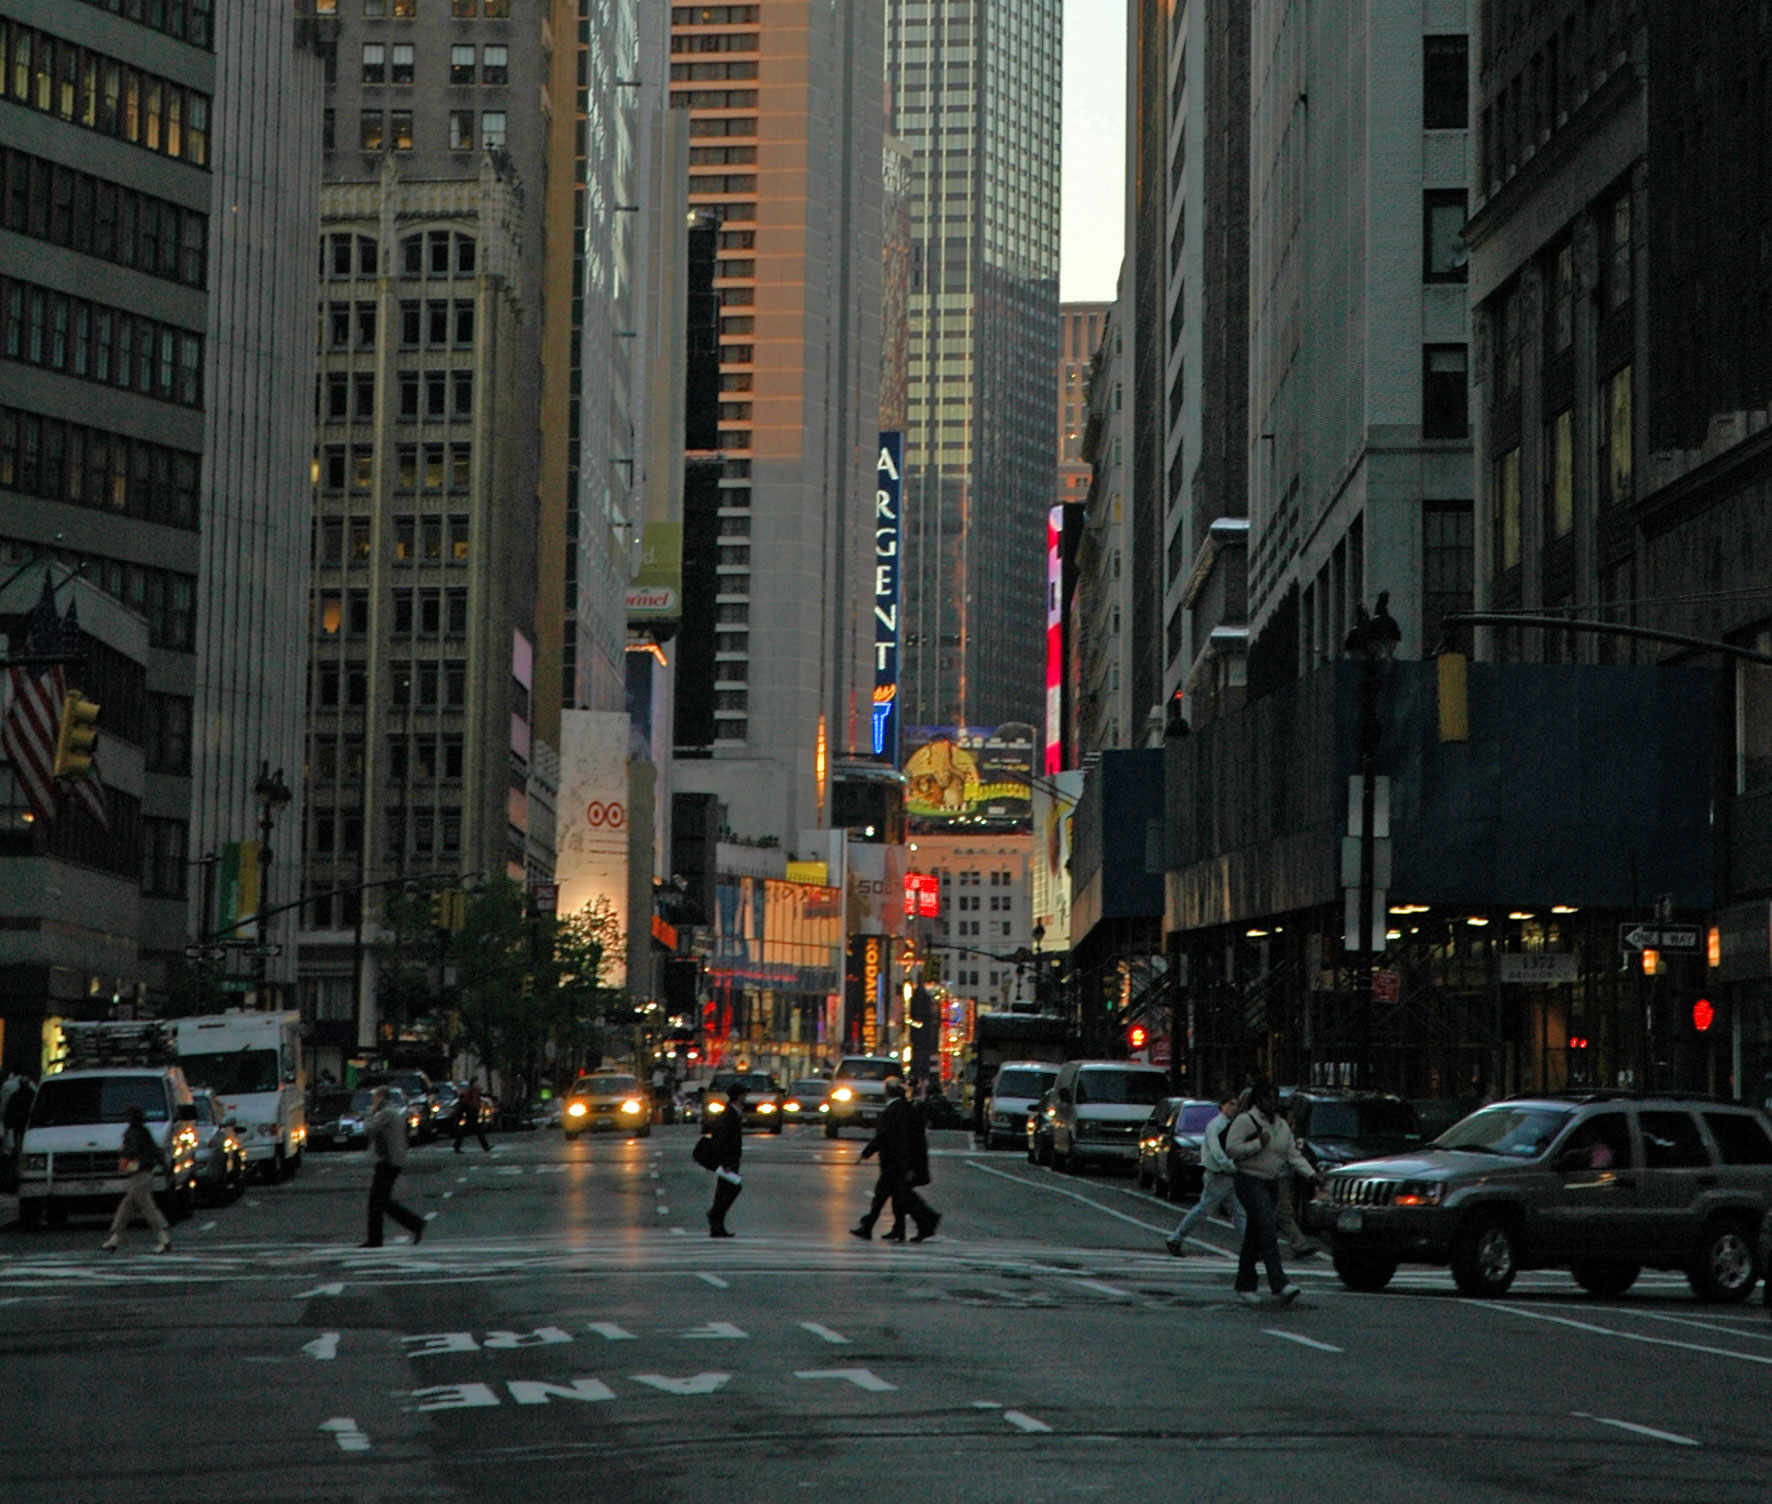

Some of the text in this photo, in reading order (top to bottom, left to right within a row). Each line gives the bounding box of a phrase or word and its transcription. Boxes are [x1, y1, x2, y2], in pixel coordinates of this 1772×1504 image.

[874, 446, 899, 670] ARGENT
[864, 936, 880, 1003] KODAK
[1631, 932, 1694, 946] ONE WAY
